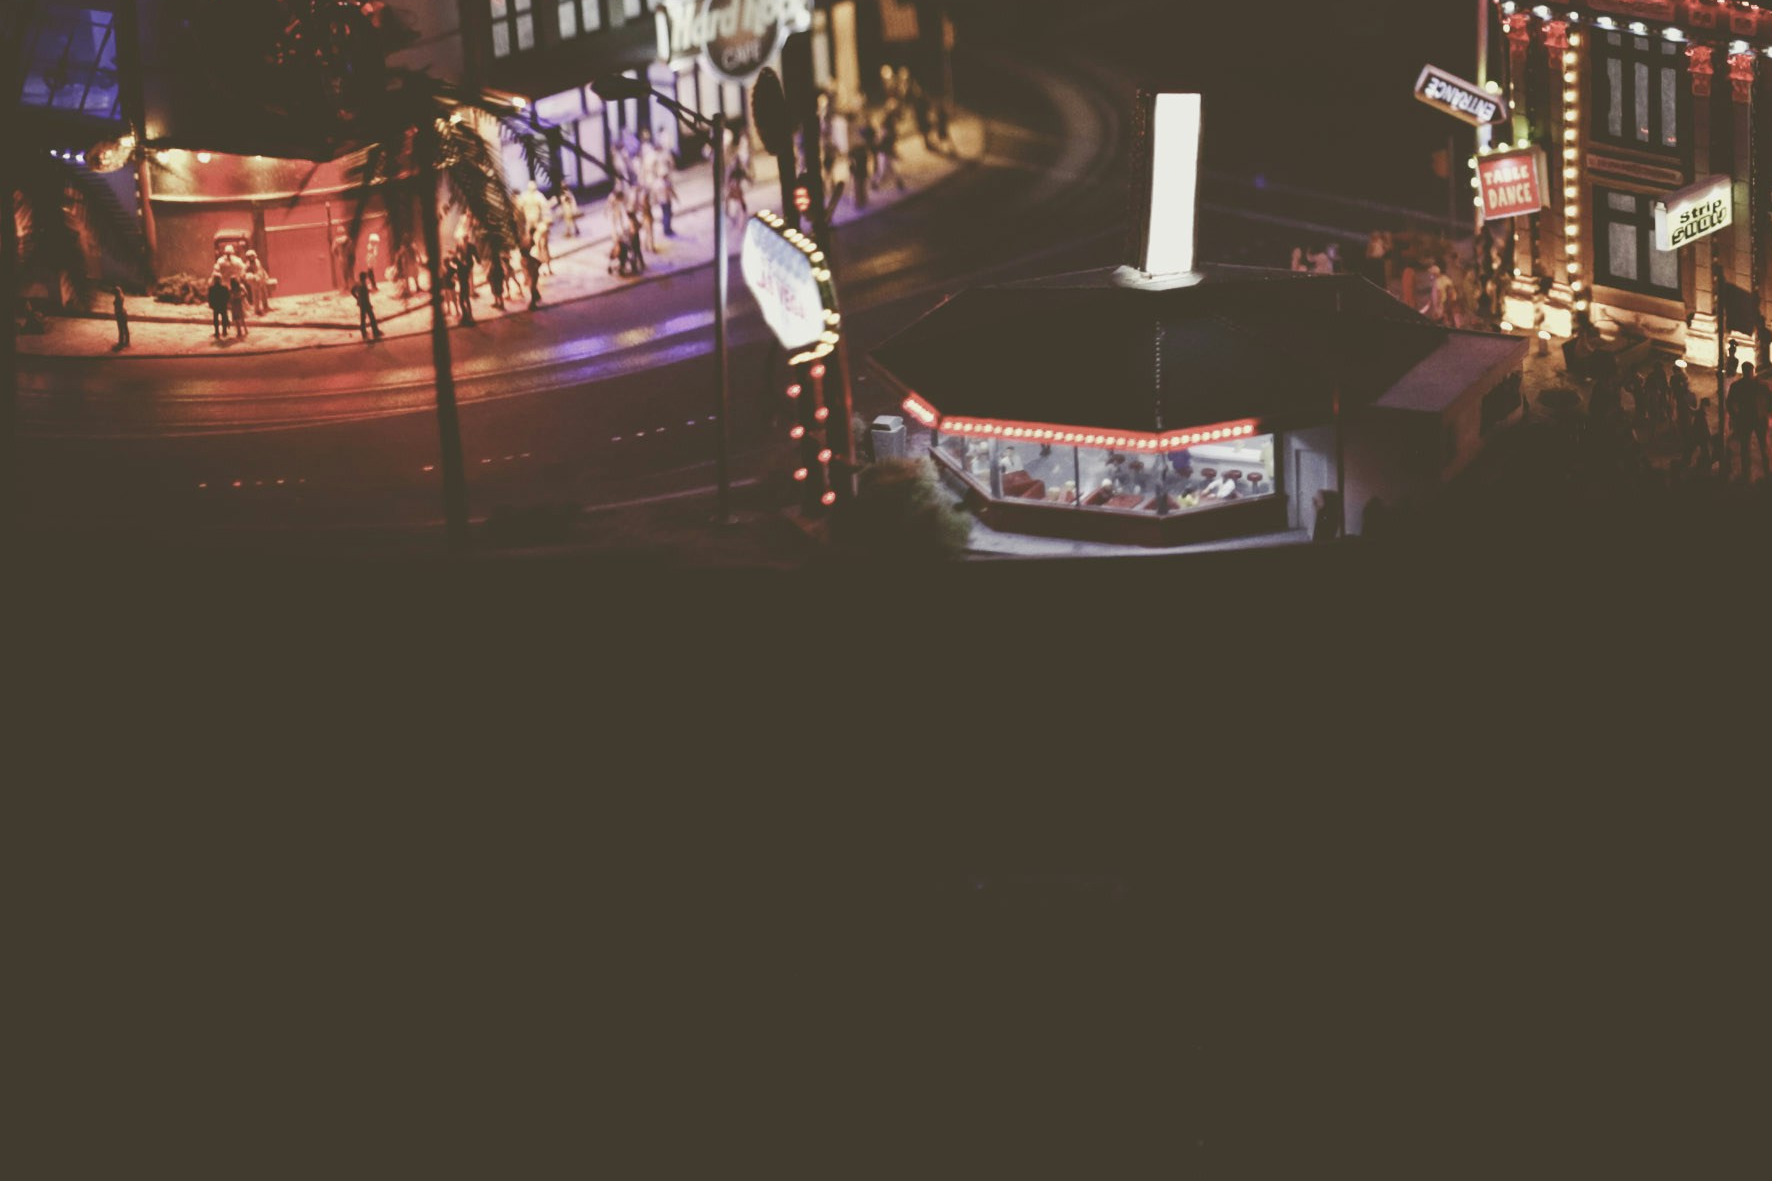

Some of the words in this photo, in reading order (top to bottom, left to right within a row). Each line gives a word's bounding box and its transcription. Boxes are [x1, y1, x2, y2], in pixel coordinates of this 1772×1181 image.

[1425, 77, 1496, 122] ENTRANCE
[1483, 165, 1530, 186] TABLE
[1487, 182, 1533, 210] DANCE
[1671, 207, 1727, 245] SHOW
[1680, 200, 1722, 224] Strip
